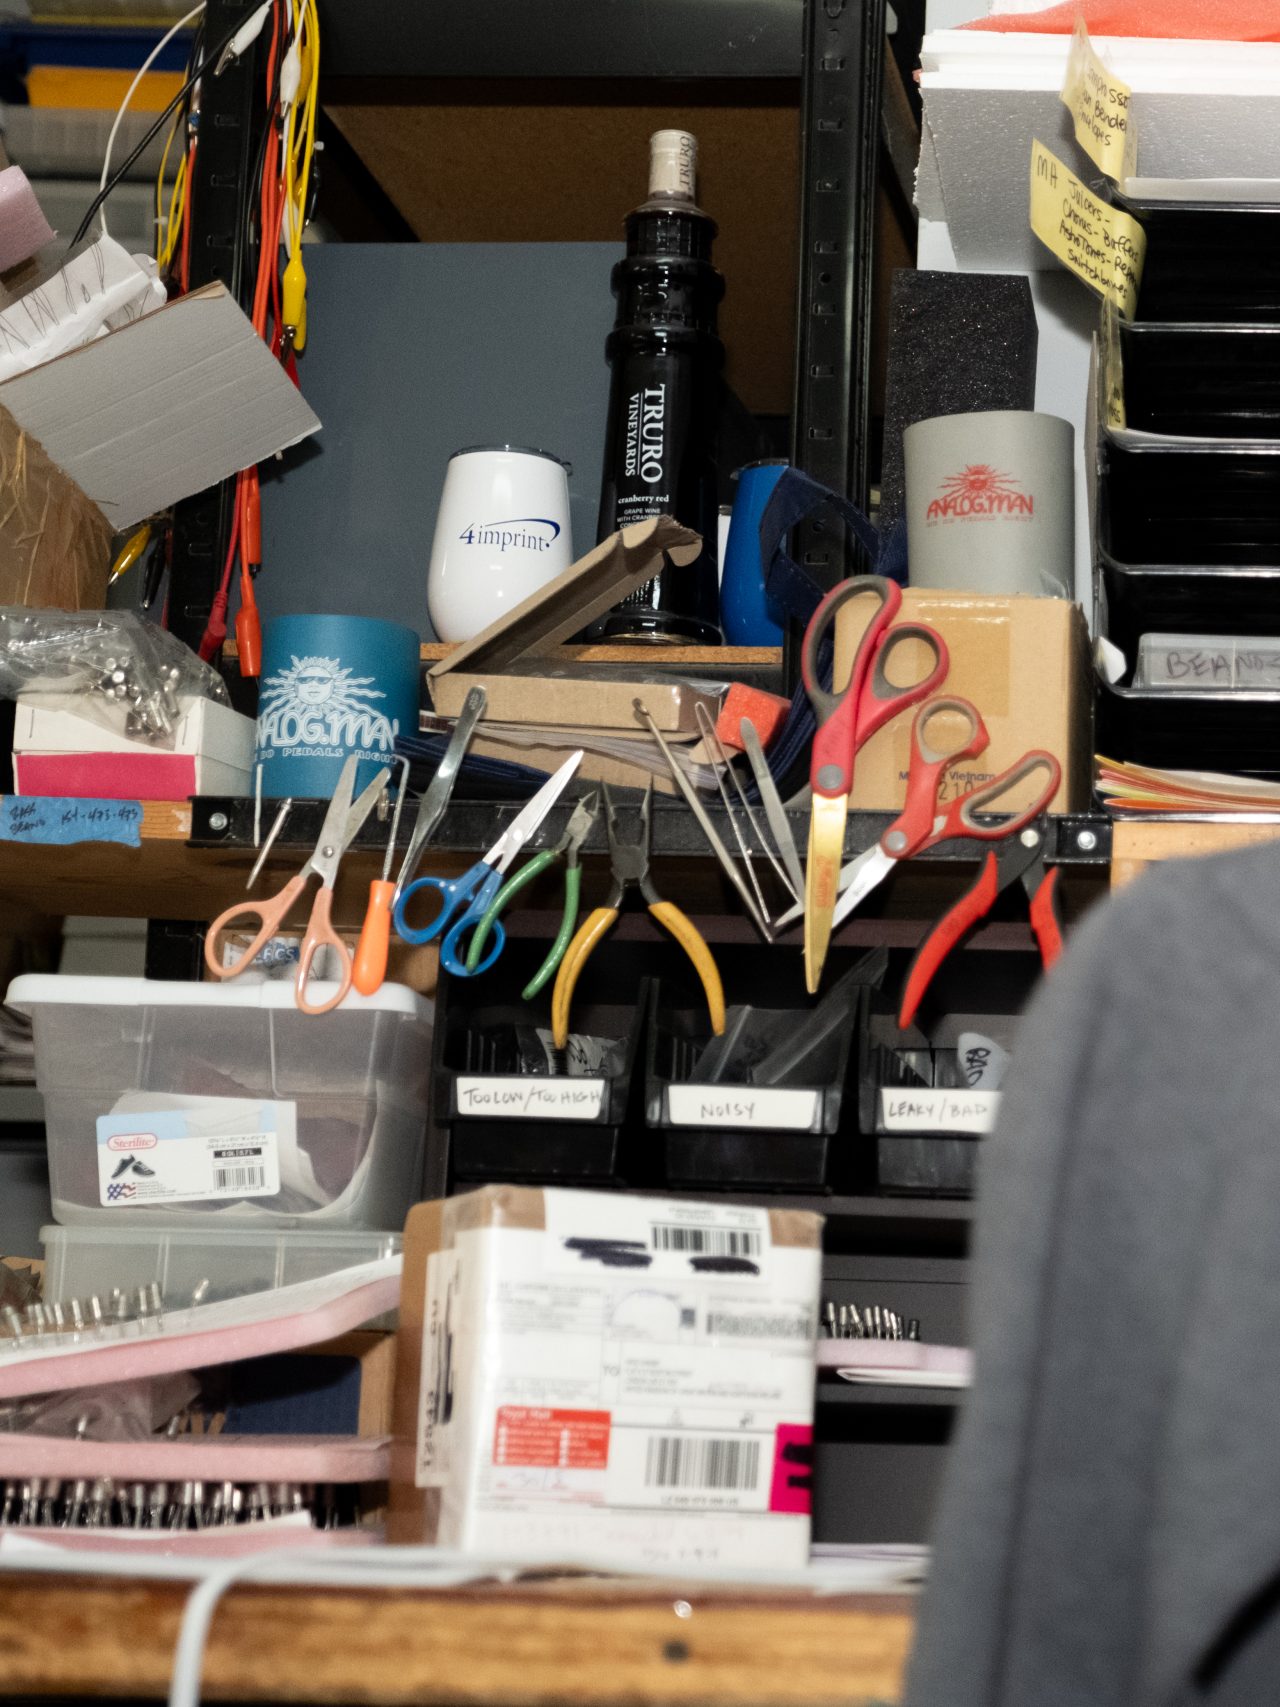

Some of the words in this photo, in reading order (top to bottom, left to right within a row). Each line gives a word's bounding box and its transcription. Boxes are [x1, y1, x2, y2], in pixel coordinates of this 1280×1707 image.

[624, 392, 640, 477] VINEYARDS
[640, 383, 666, 484] TRURO
[617, 494, 655, 505] cranberry
[656, 494, 670, 503] red
[458, 521, 544, 552] 4imprint
[282, 747, 344, 758] PEDALS
[950, 771, 998, 782] Vietnam
[700, 1102, 756, 1120] NOISY
[113, 1138, 155, 1149] Sterilite
